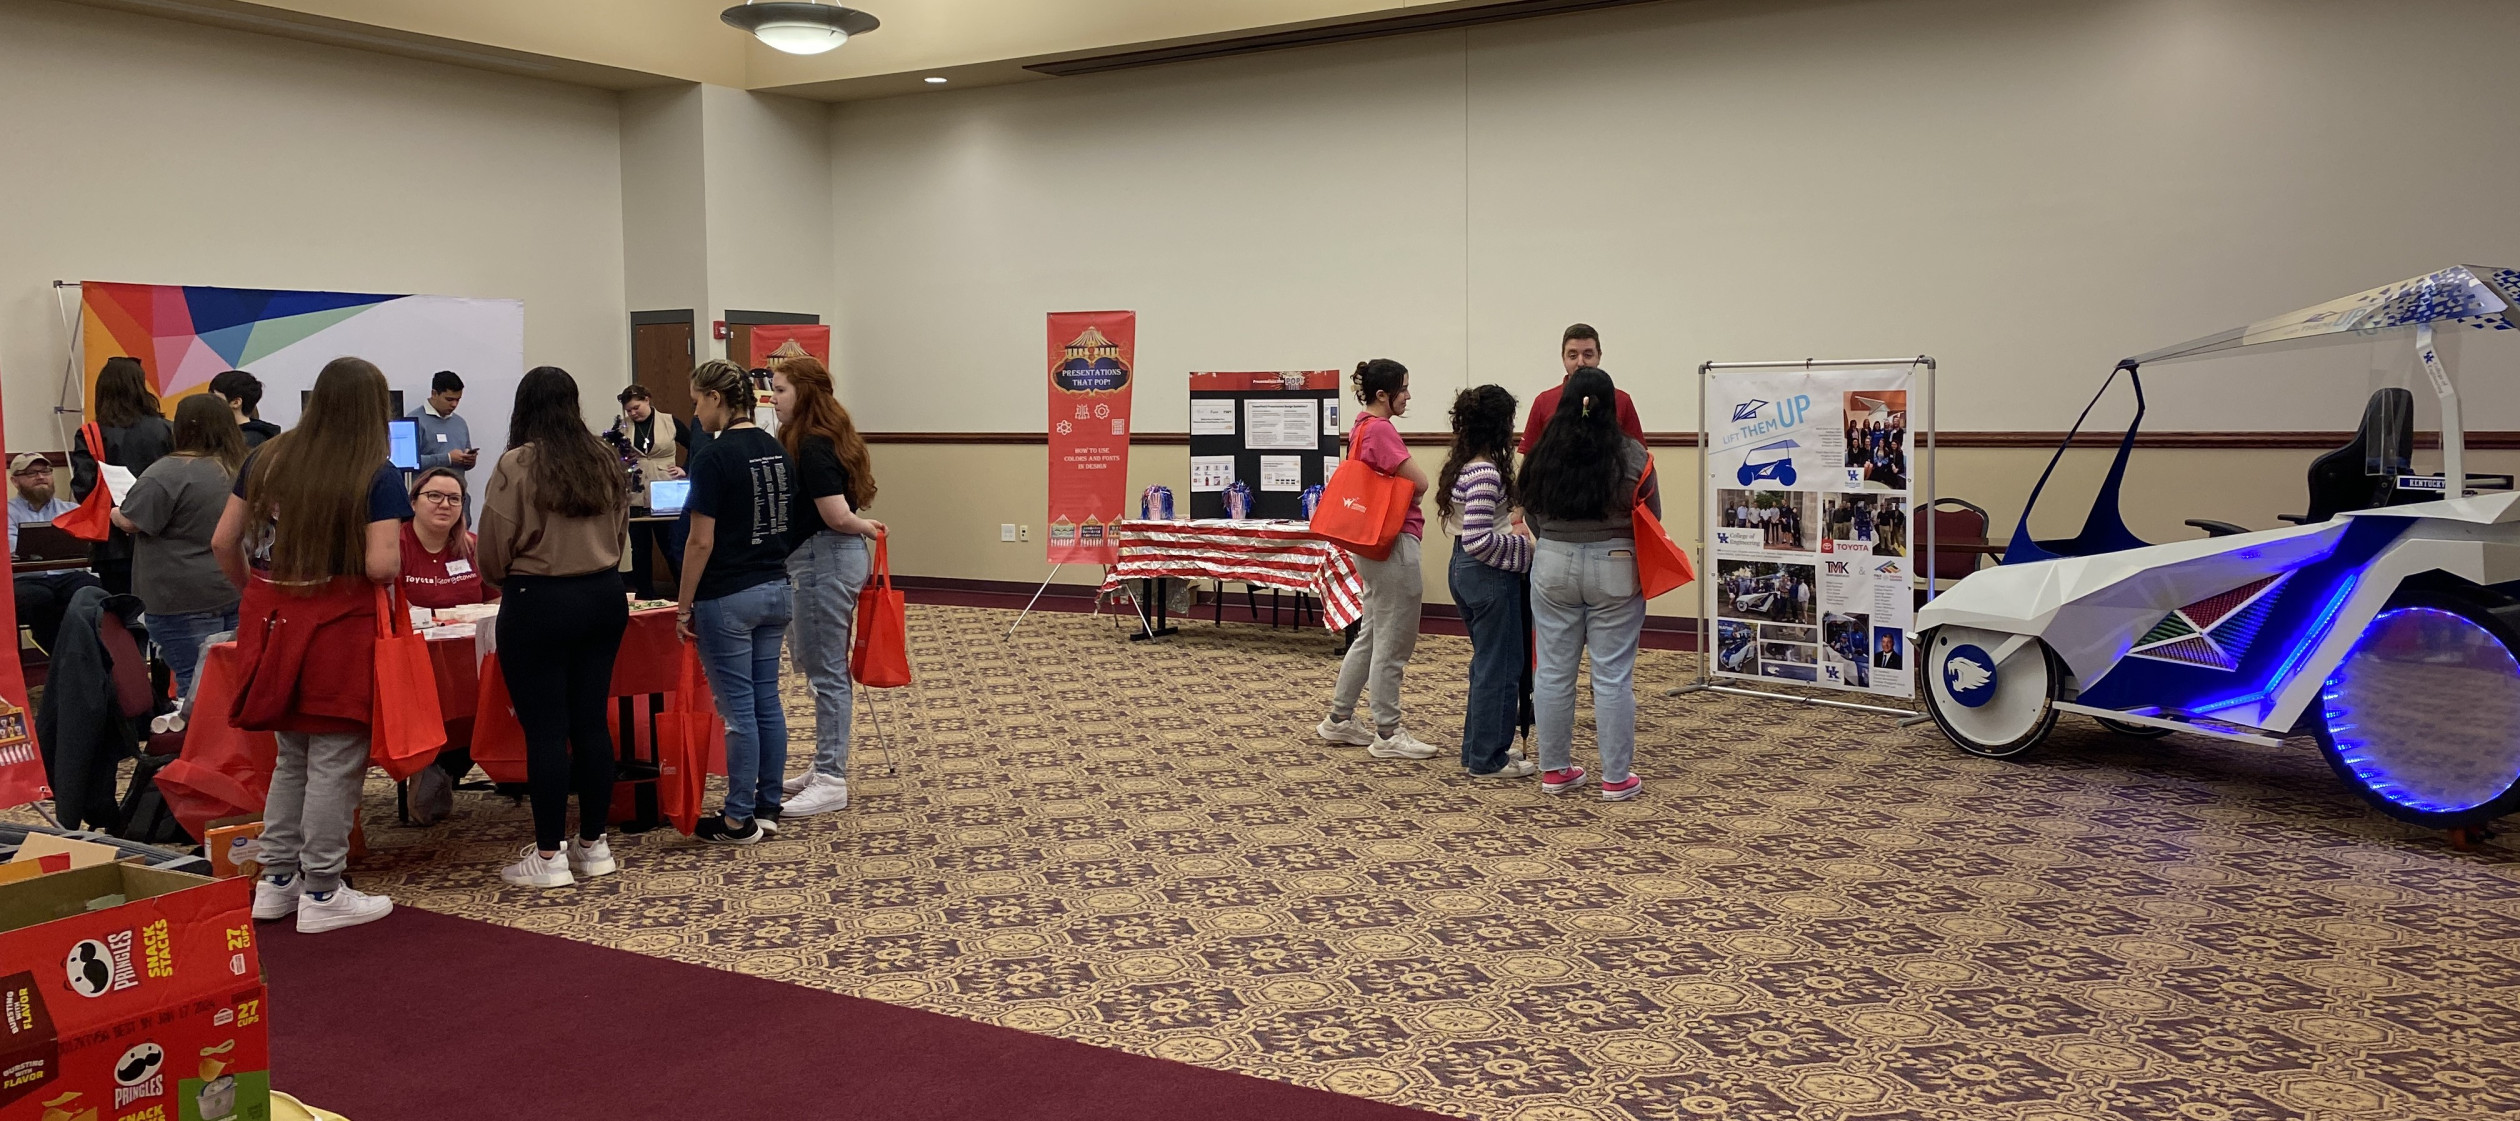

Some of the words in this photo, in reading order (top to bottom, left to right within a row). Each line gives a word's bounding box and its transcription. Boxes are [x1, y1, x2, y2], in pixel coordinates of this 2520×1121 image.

[1722, 433, 1740, 445] LIFT
[1740, 418, 1778, 439] THEM
[1776, 394, 1811, 428] UP
[2409, 479, 2446, 488] KENTUCKY
[1836, 543, 1869, 551] TOYOTA
[1825, 560, 1849, 574] TMK
[405, 575, 434, 584] Toyota
[226, 928, 243, 951] 27
[240, 924, 250, 948] CUPS
[142, 924, 161, 978] SNACK
[155, 918, 173, 977] STACKS
[107, 930, 139, 991] PRINGLES
[6, 991, 19, 1034] BURSTING
[14, 1001, 22, 1021] WITH
[19, 987, 33, 1030] FLAVOR
[237, 1000, 259, 1018] 27
[237, 1014, 260, 1028] CUPS
[2, 1059, 45, 1077] BURSTING
[14, 1068, 33, 1078] WITH
[3, 1070, 44, 1089] FLAVOR
[114, 1074, 163, 1110] PRINGLES
